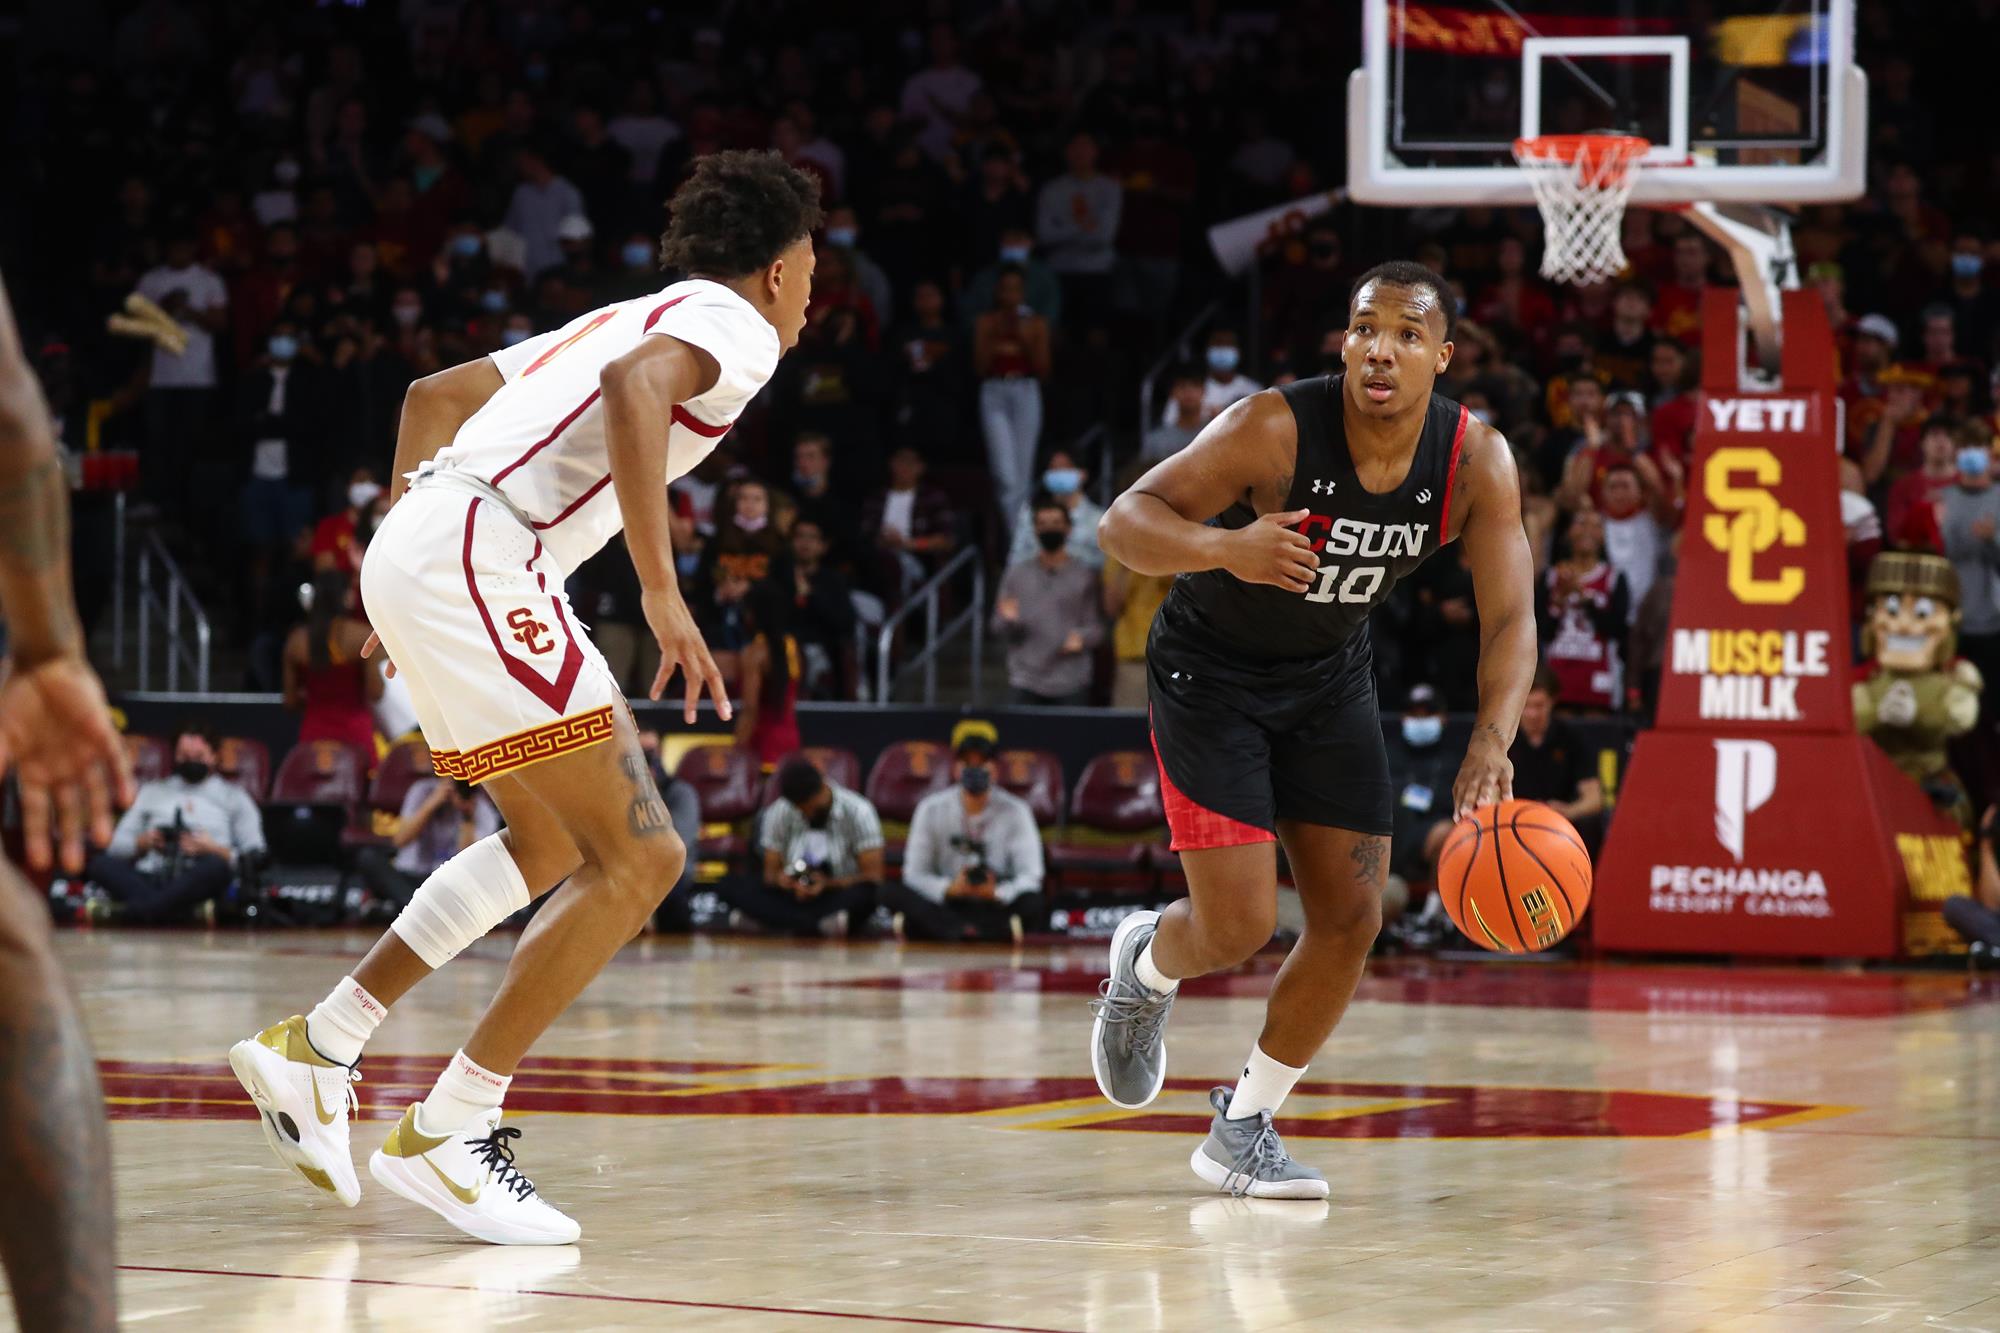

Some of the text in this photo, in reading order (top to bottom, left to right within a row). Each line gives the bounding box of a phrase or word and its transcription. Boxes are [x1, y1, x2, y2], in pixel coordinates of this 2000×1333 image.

[1707, 399, 1808, 432] YETI
[1298, 514, 1429, 558] CSUN
[1703, 447, 1807, 604] SC
[1304, 565, 1386, 604] 10
[506, 607, 555, 655] SC
[1672, 628, 1830, 677] MUSCLE
[1700, 674, 1800, 721] MILK
[1650, 865, 1828, 898] PECHANGA
[1650, 893, 1735, 913] RESORT
[457, 1056, 503, 1087] Supreme
